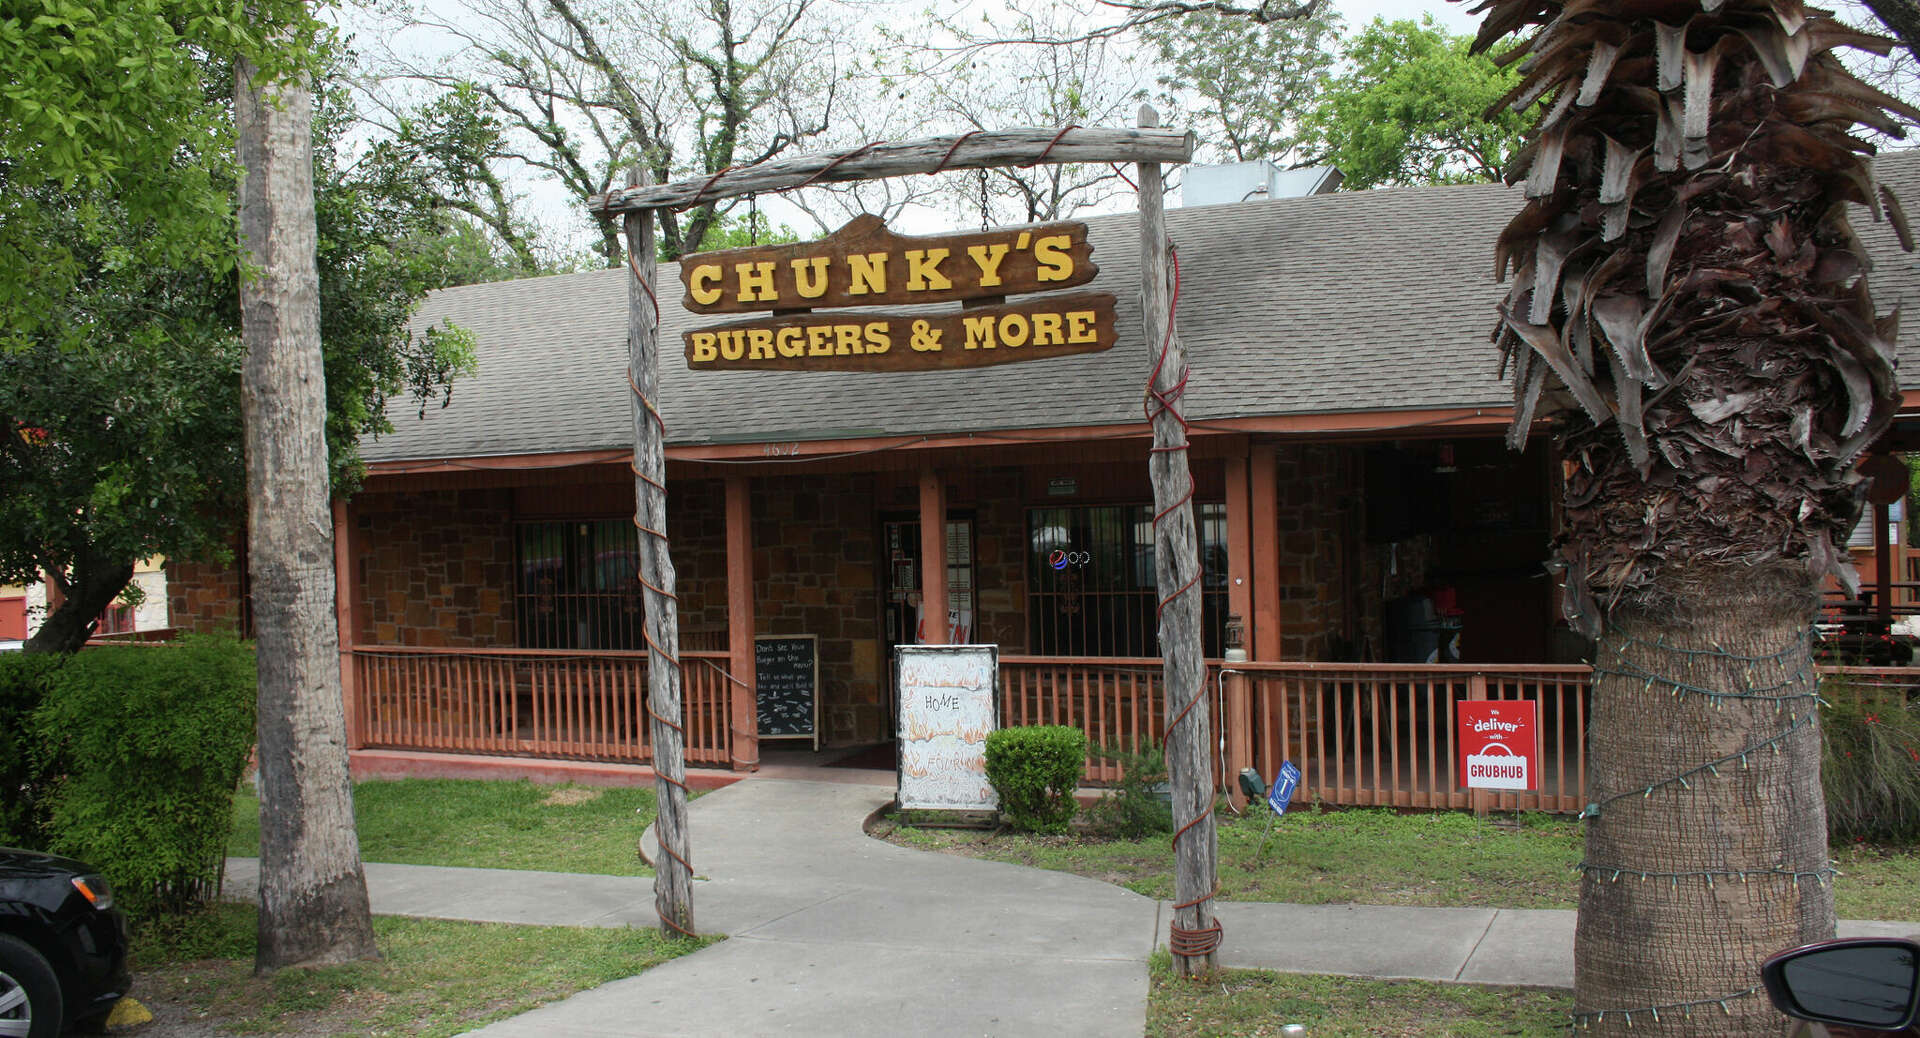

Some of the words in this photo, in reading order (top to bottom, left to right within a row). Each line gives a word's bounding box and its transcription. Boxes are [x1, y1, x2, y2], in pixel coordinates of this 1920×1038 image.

[690, 232, 1076, 305] CHUNKY'S
[691, 321, 892, 363] BURGERS
[910, 319, 943, 352] &
[962, 310, 1098, 351] MORE
[925, 694, 960, 711] HOME
[1474, 718, 1519, 733] deliver
[1489, 733, 1503, 741] with
[1471, 765, 1523, 779] GRUBHUB
